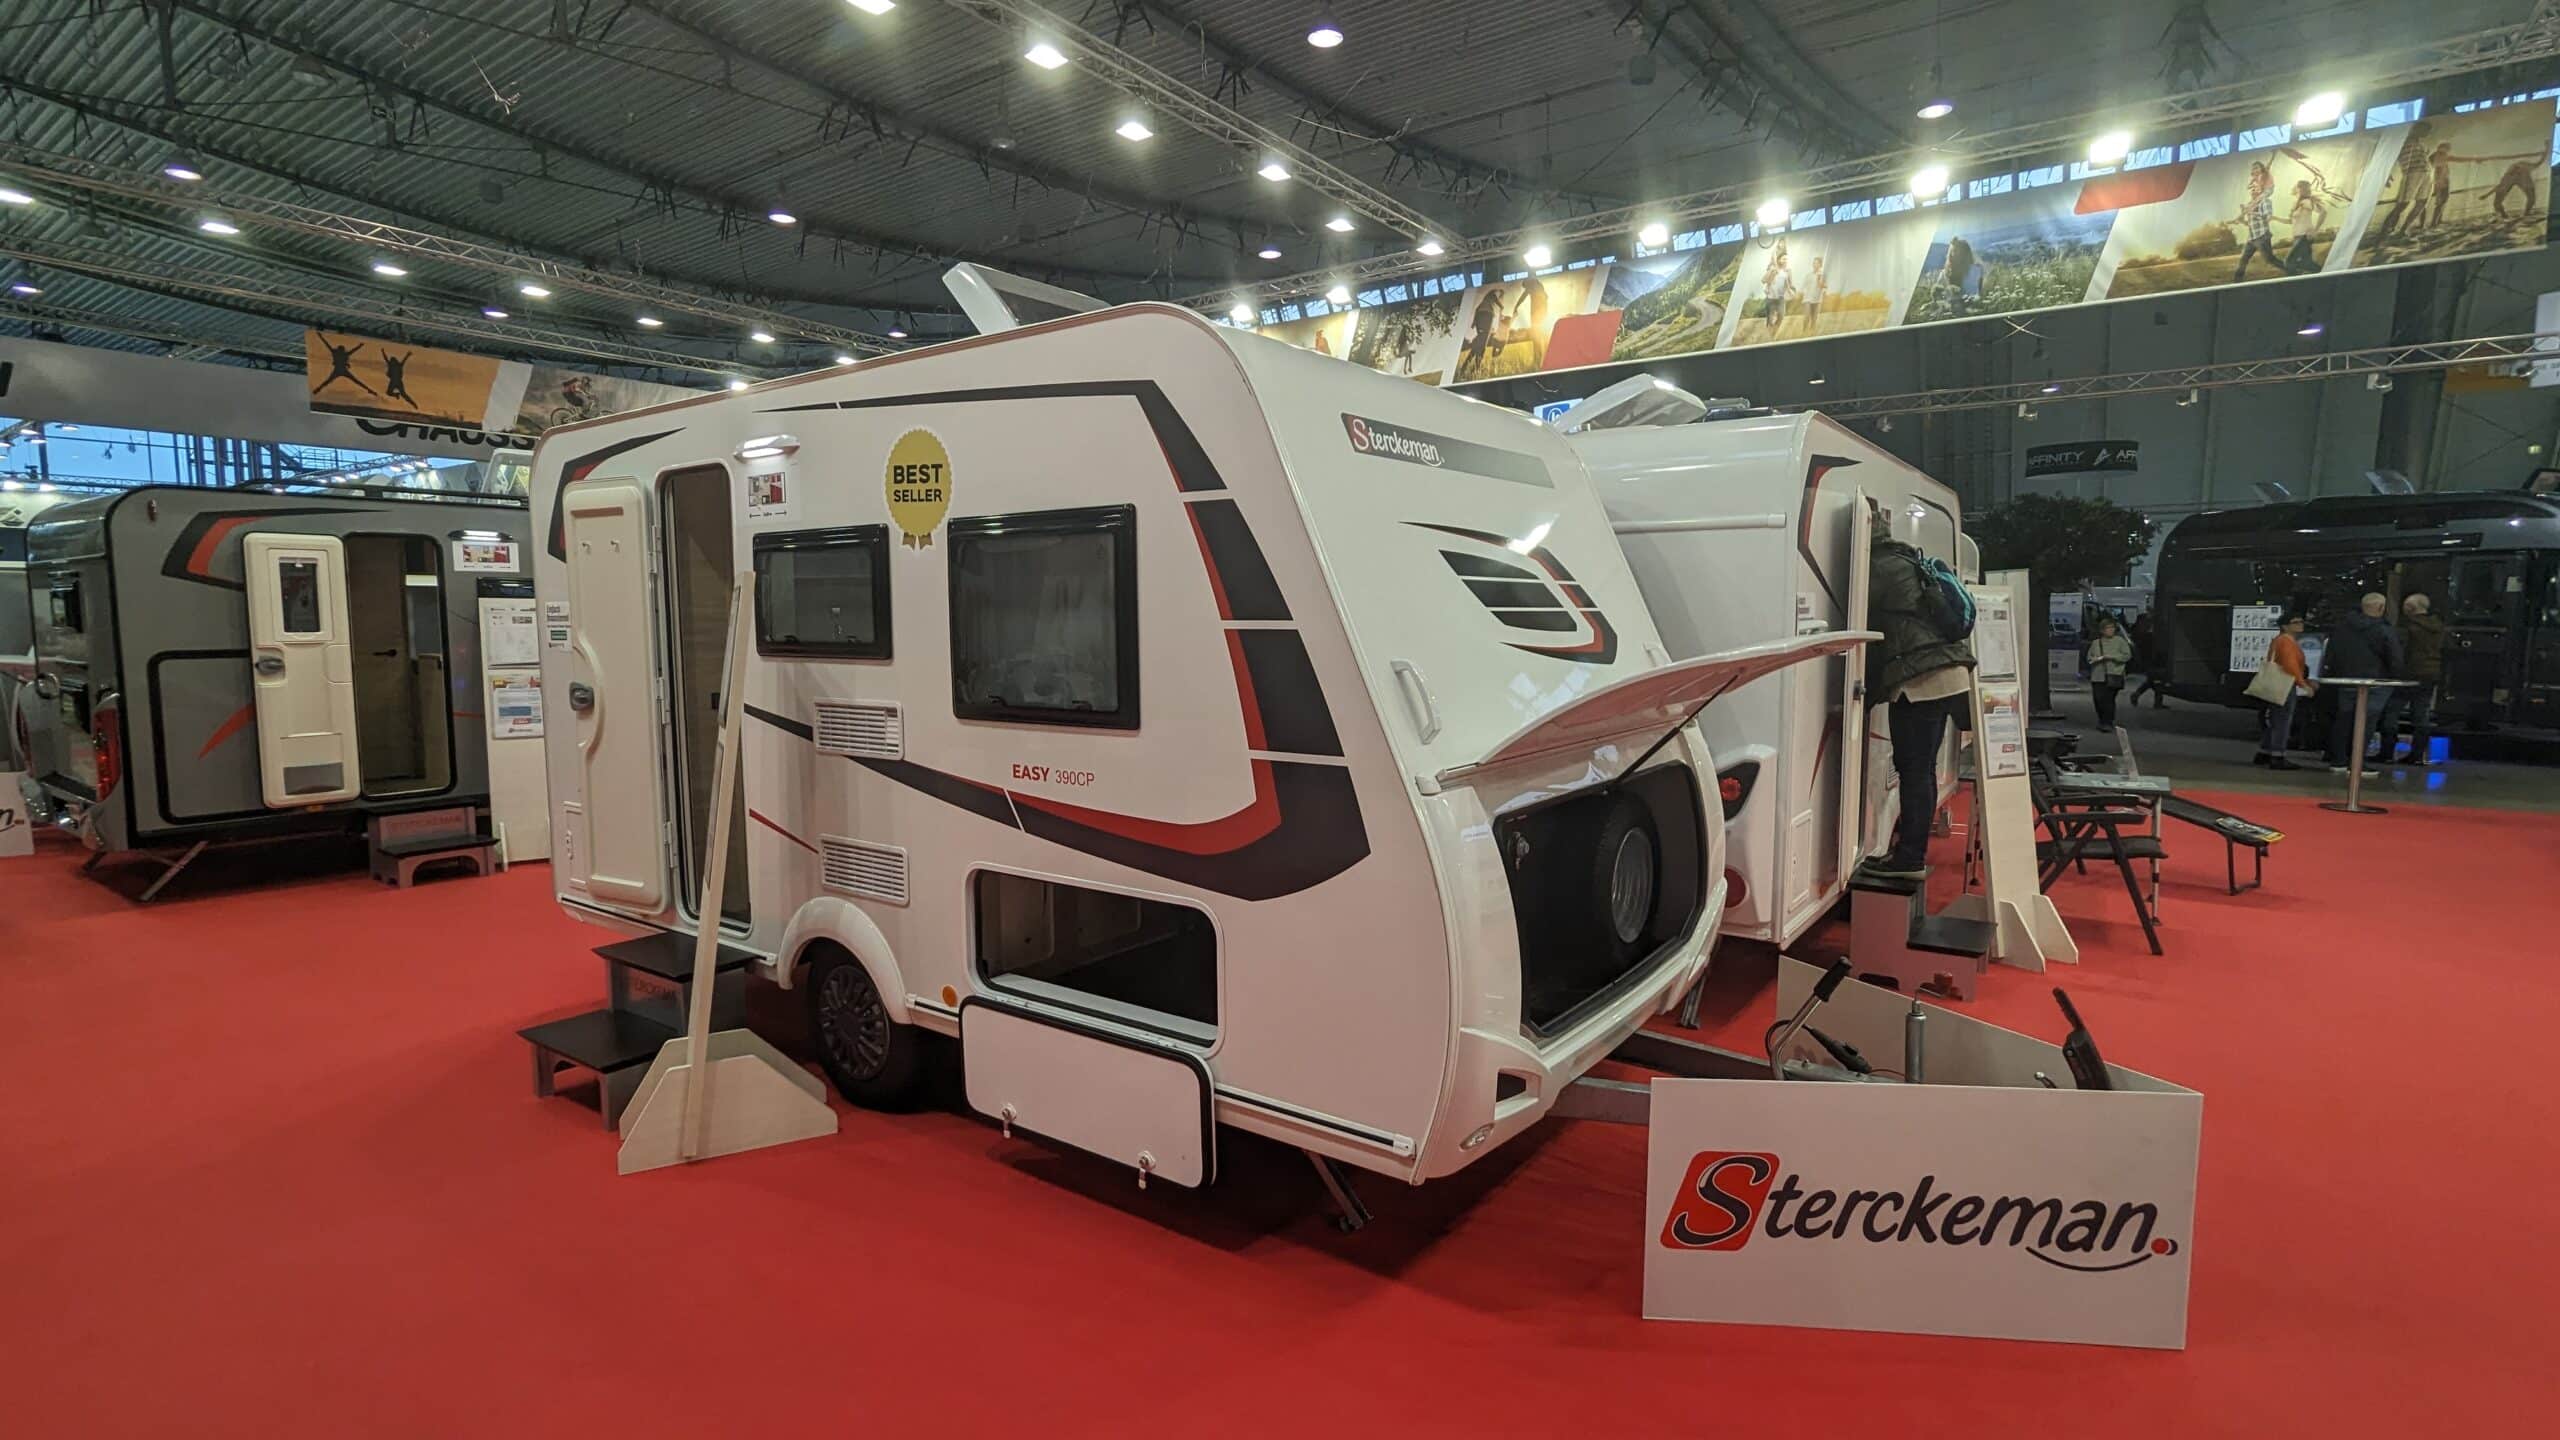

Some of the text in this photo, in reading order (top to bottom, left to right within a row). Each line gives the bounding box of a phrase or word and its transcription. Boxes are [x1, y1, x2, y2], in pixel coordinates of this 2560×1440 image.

[893, 463, 943, 485] BEST
[893, 489, 943, 503] SELLER
[1012, 763, 1095, 786] EASY 390CP
